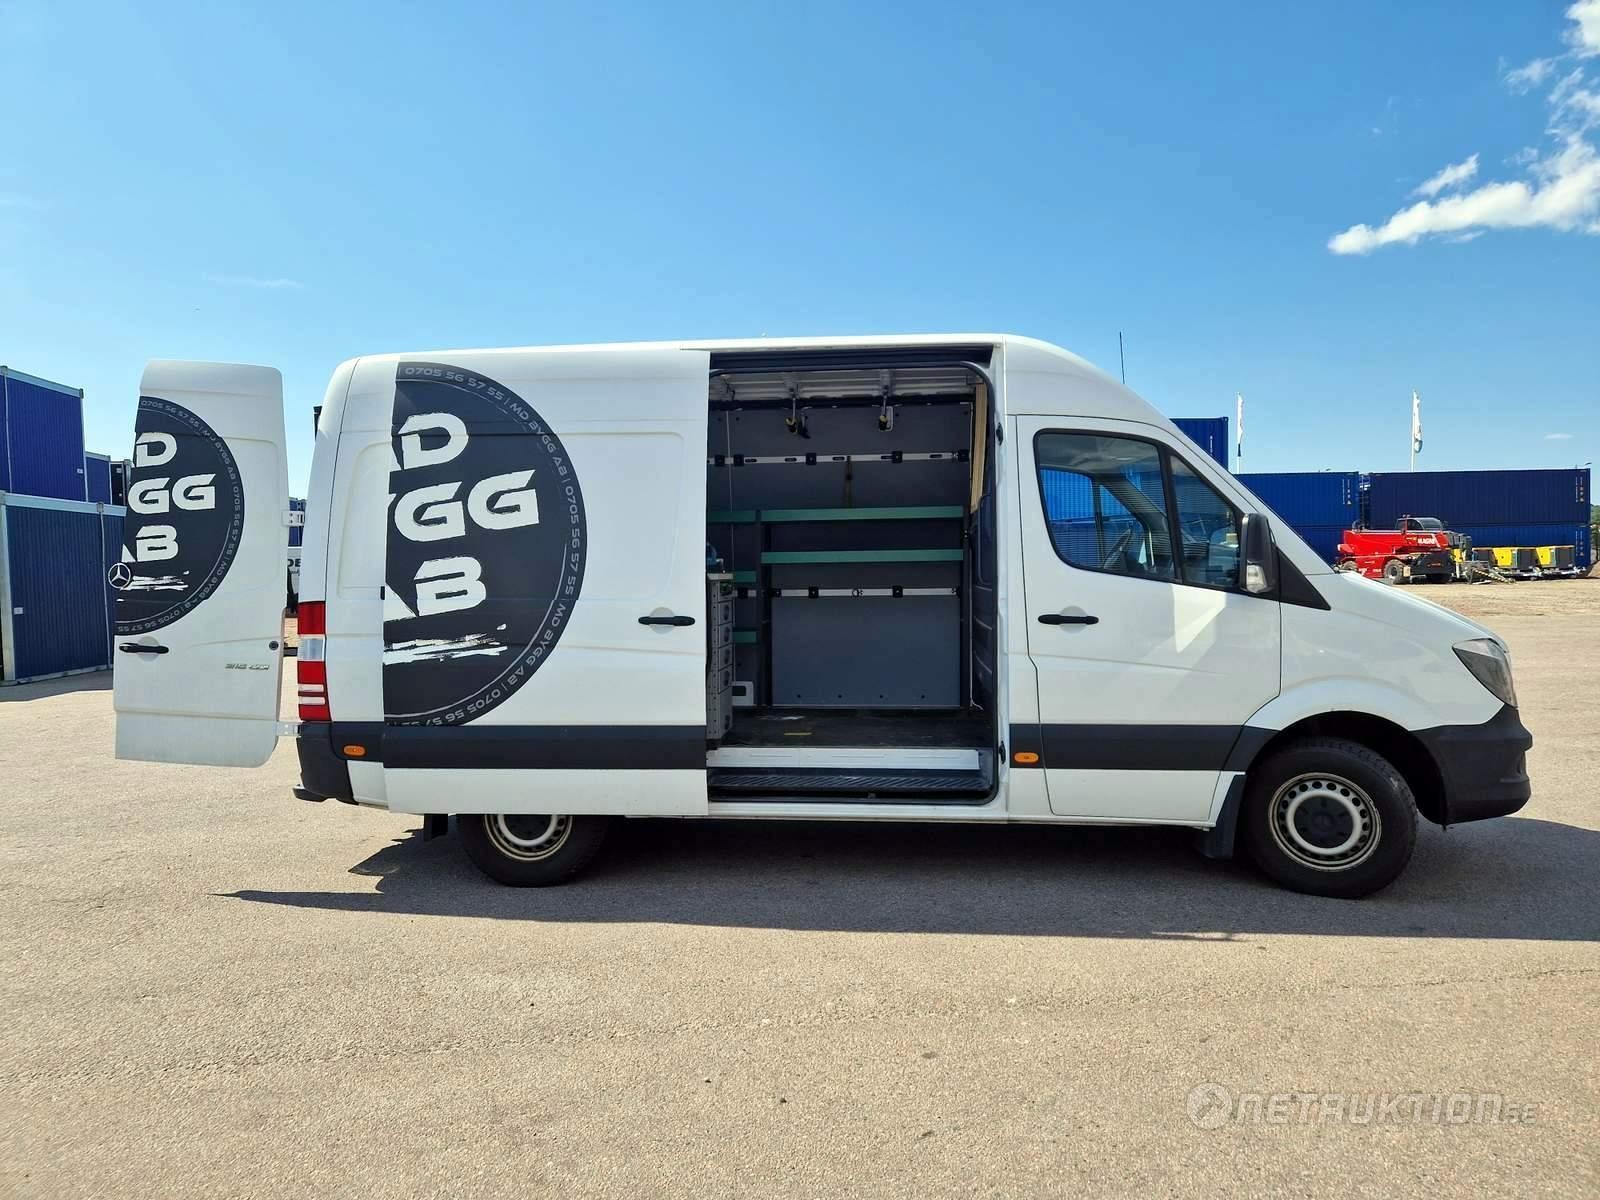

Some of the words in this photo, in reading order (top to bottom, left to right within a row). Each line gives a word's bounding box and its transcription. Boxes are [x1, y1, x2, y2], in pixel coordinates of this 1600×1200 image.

[405, 367, 442, 377] 0705
[445, 371, 465, 382] 56
[467, 377, 486, 389] 57
[487, 386, 505, 401] 55
[509, 402, 529, 420] MD
[528, 420, 557, 453] BYGG
[552, 456, 568, 476] AB
[565, 486, 579, 524] 0705
[571, 528, 580, 549] 56
[570, 552, 579, 572] 57
[565, 575, 576, 595] 55
[551, 603, 566, 627] MD
[525, 629, 554, 666] BYGG
[507, 665, 524, 685] AB
[466, 688, 501, 713] 0705
[445, 709, 465, 722] 56
